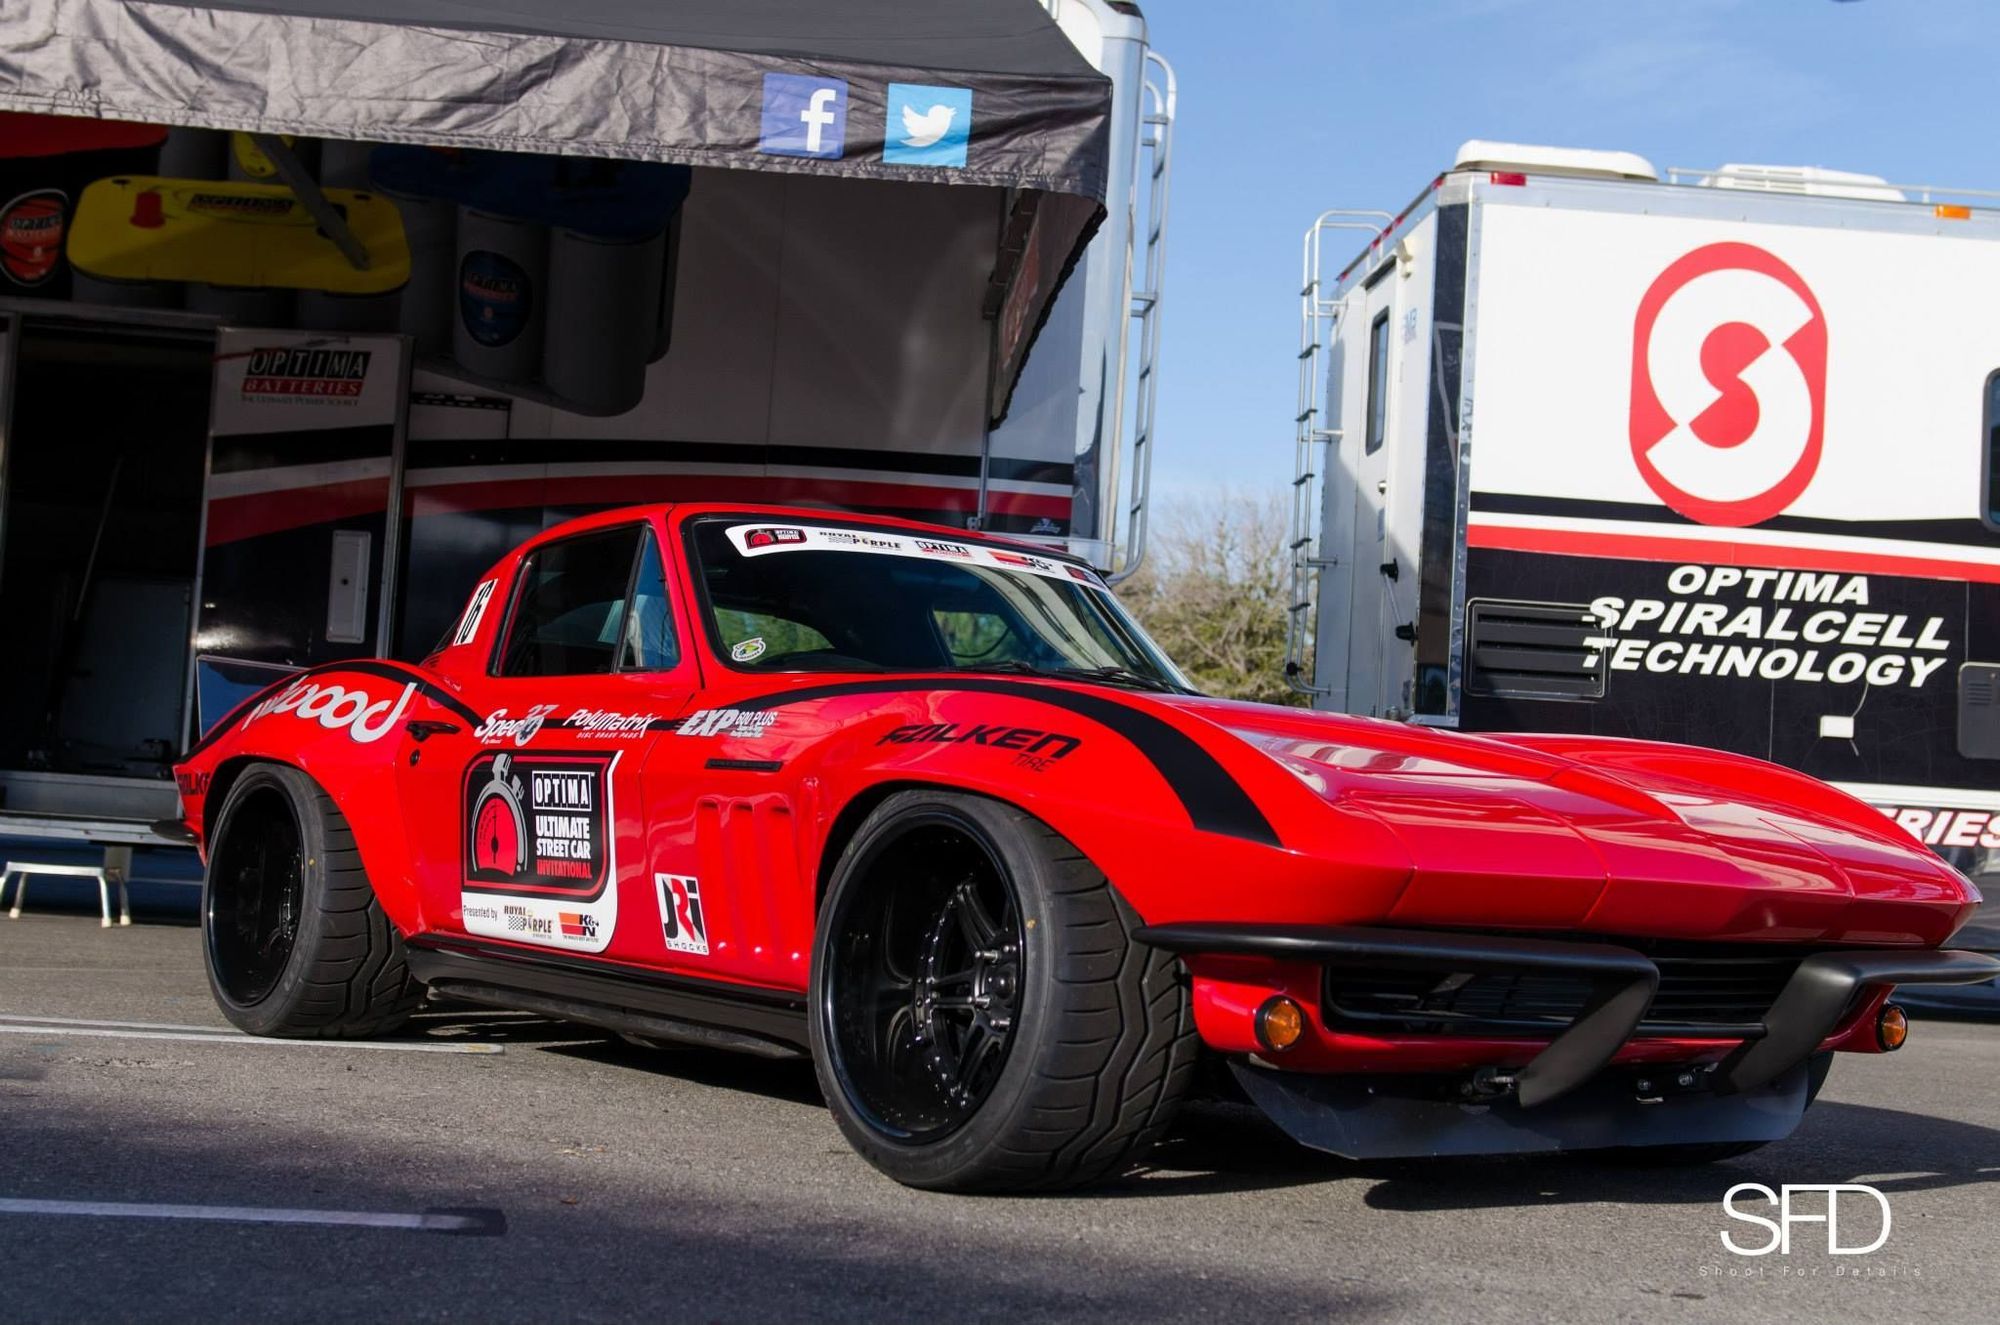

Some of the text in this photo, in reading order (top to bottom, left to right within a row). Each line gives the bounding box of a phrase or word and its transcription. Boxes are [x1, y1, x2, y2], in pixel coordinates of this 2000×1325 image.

[248, 350, 369, 378] OPTIMA
[244, 378, 361, 395] BATTERIES
[1666, 564, 1870, 606] OPTIMA
[1581, 596, 1951, 650] SPIRALCELL
[1581, 636, 1948, 688] TECHNOLOGY
[675, 709, 740, 737] EXP
[749, 711, 779, 727] PLUS
[1010, 752, 1056, 773] TIRE
[535, 777, 589, 805] OPTIMA
[535, 815, 591, 839] ULTIMATE
[536, 838, 592, 859] STREET CAR
[536, 859, 593, 879] INVITATIONAL
[463, 904, 498, 921] Presented by
[504, 905, 526, 916] ROYAL
[666, 940, 708, 953] SHOCKS
